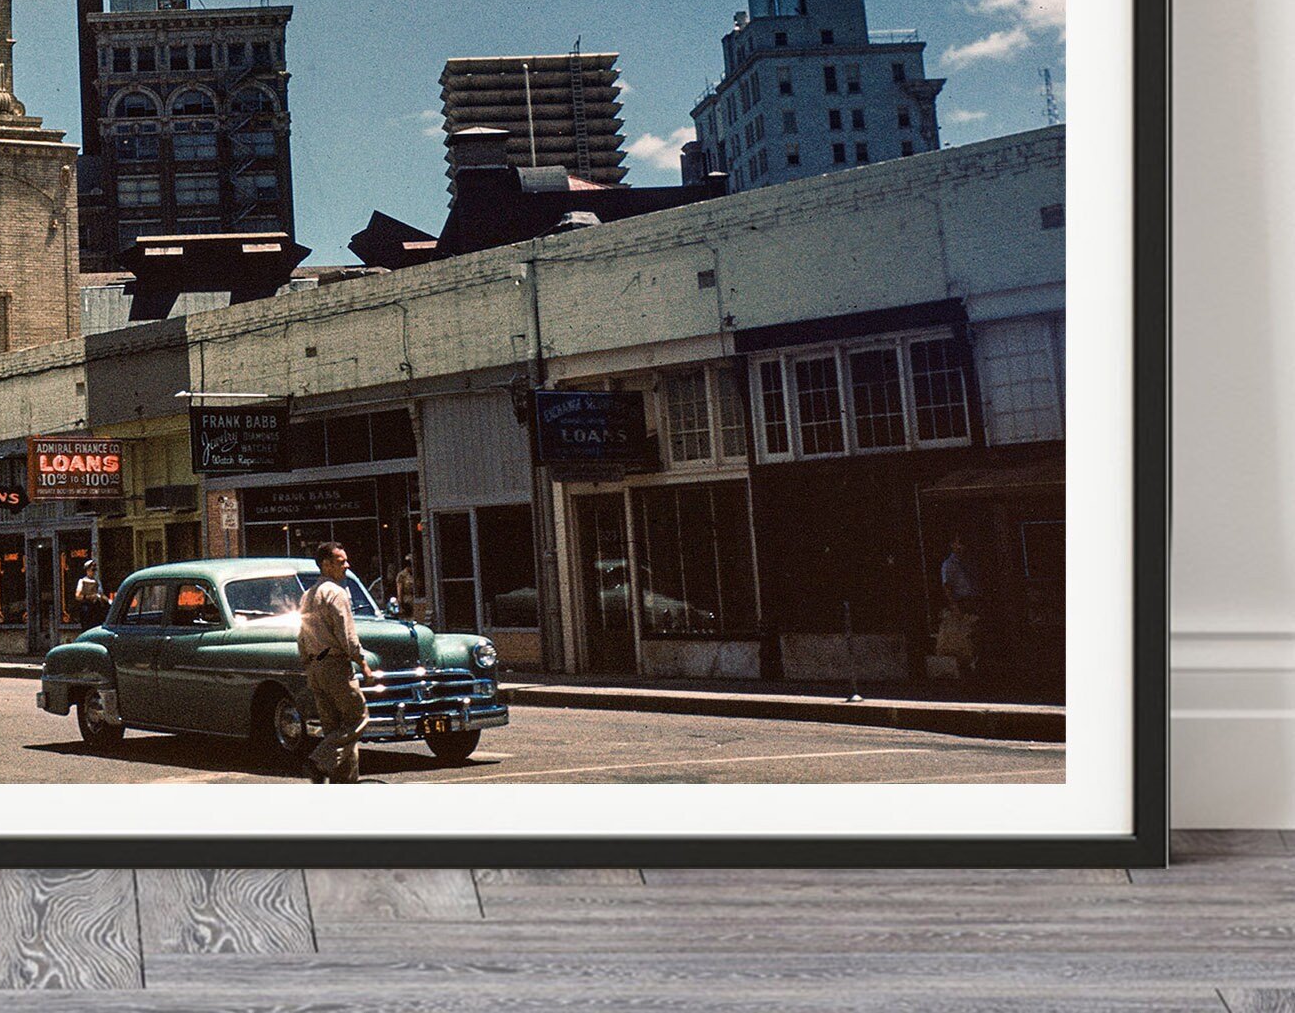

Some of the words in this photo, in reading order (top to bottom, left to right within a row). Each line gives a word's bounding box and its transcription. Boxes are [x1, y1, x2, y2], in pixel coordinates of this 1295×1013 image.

[202, 415, 240, 428] FRANK
[246, 415, 277, 428] BABB
[561, 429, 627, 443] LOANS
[36, 443, 73, 454] ADMIRAL
[74, 443, 108, 453] FINANCE
[39, 454, 120, 472] LOANS
[212, 455, 234, 465] Watch
[70, 475, 79, 483] TO
[272, 492, 306, 502] FRANK
[314, 501, 361, 511] WATCHES
